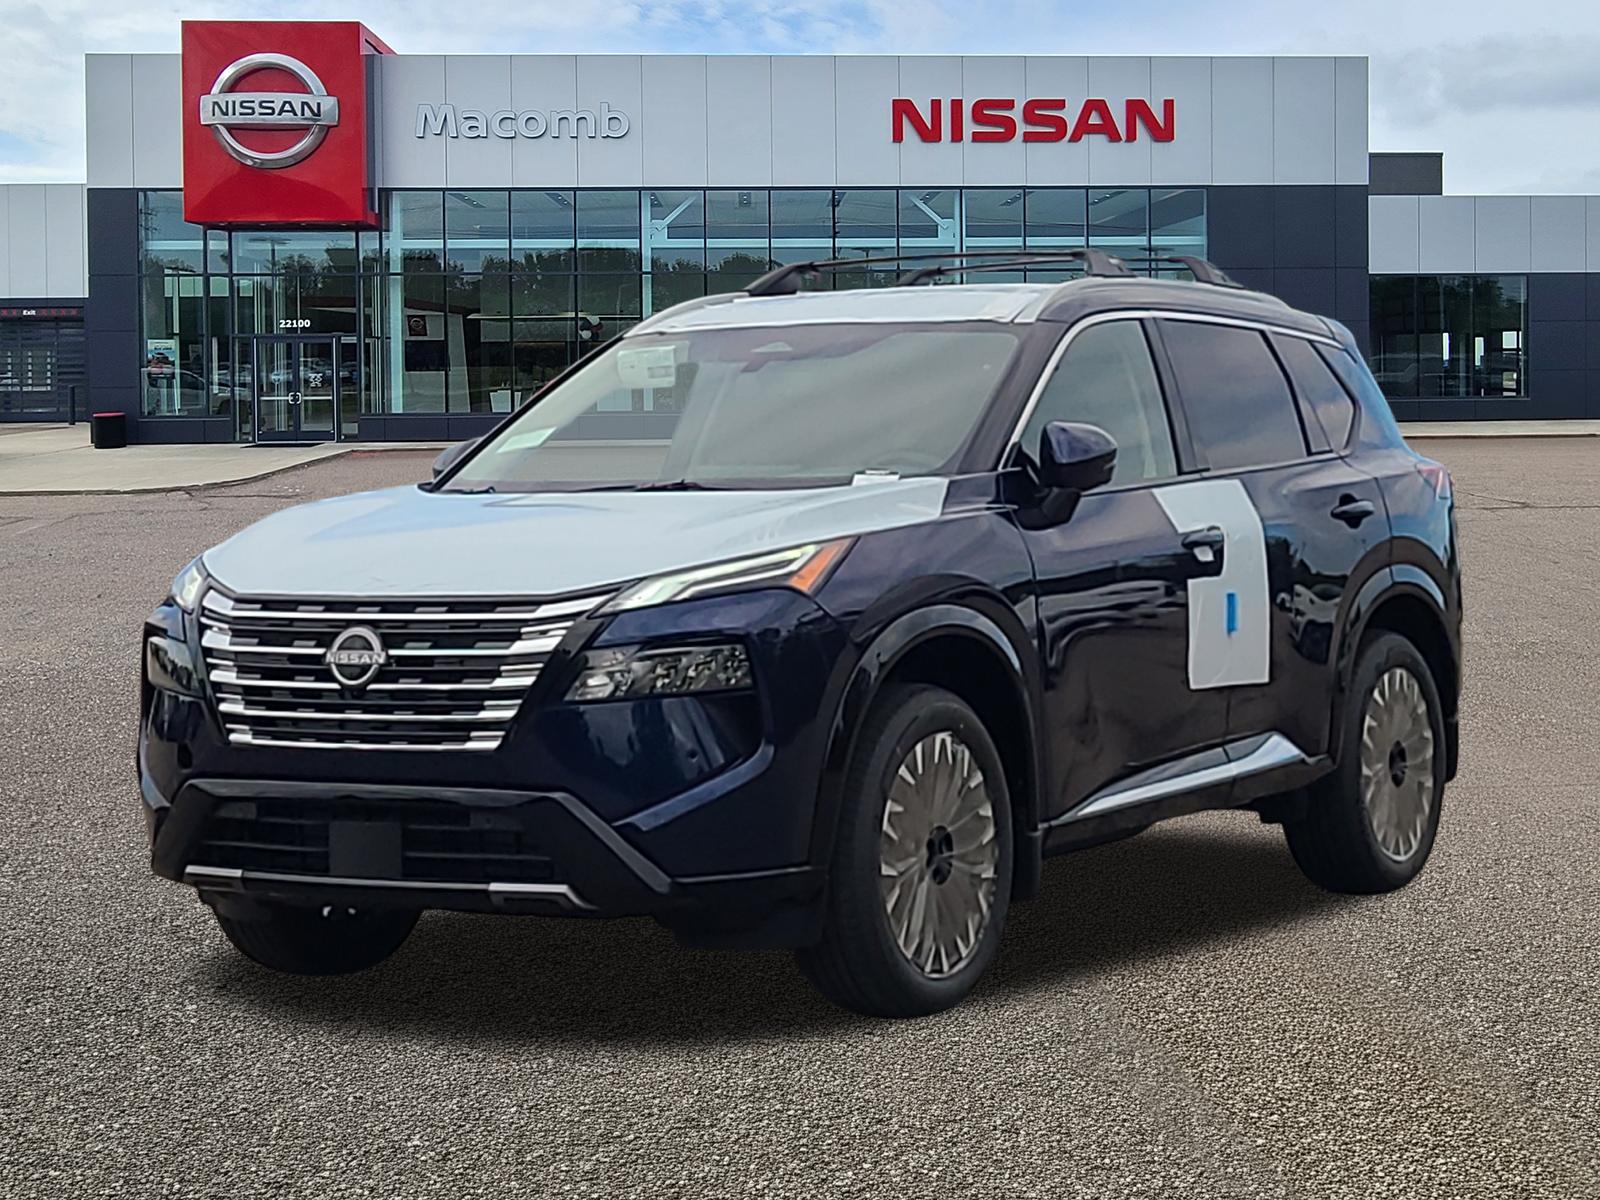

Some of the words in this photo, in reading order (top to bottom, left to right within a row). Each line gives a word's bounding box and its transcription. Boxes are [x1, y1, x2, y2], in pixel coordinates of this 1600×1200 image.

[211, 99, 322, 118] NISSAN
[415, 102, 630, 139] Macomb
[892, 98, 1175, 143] NISSAN
[279, 319, 311, 328] 22100
[326, 651, 386, 664] NISSAN
